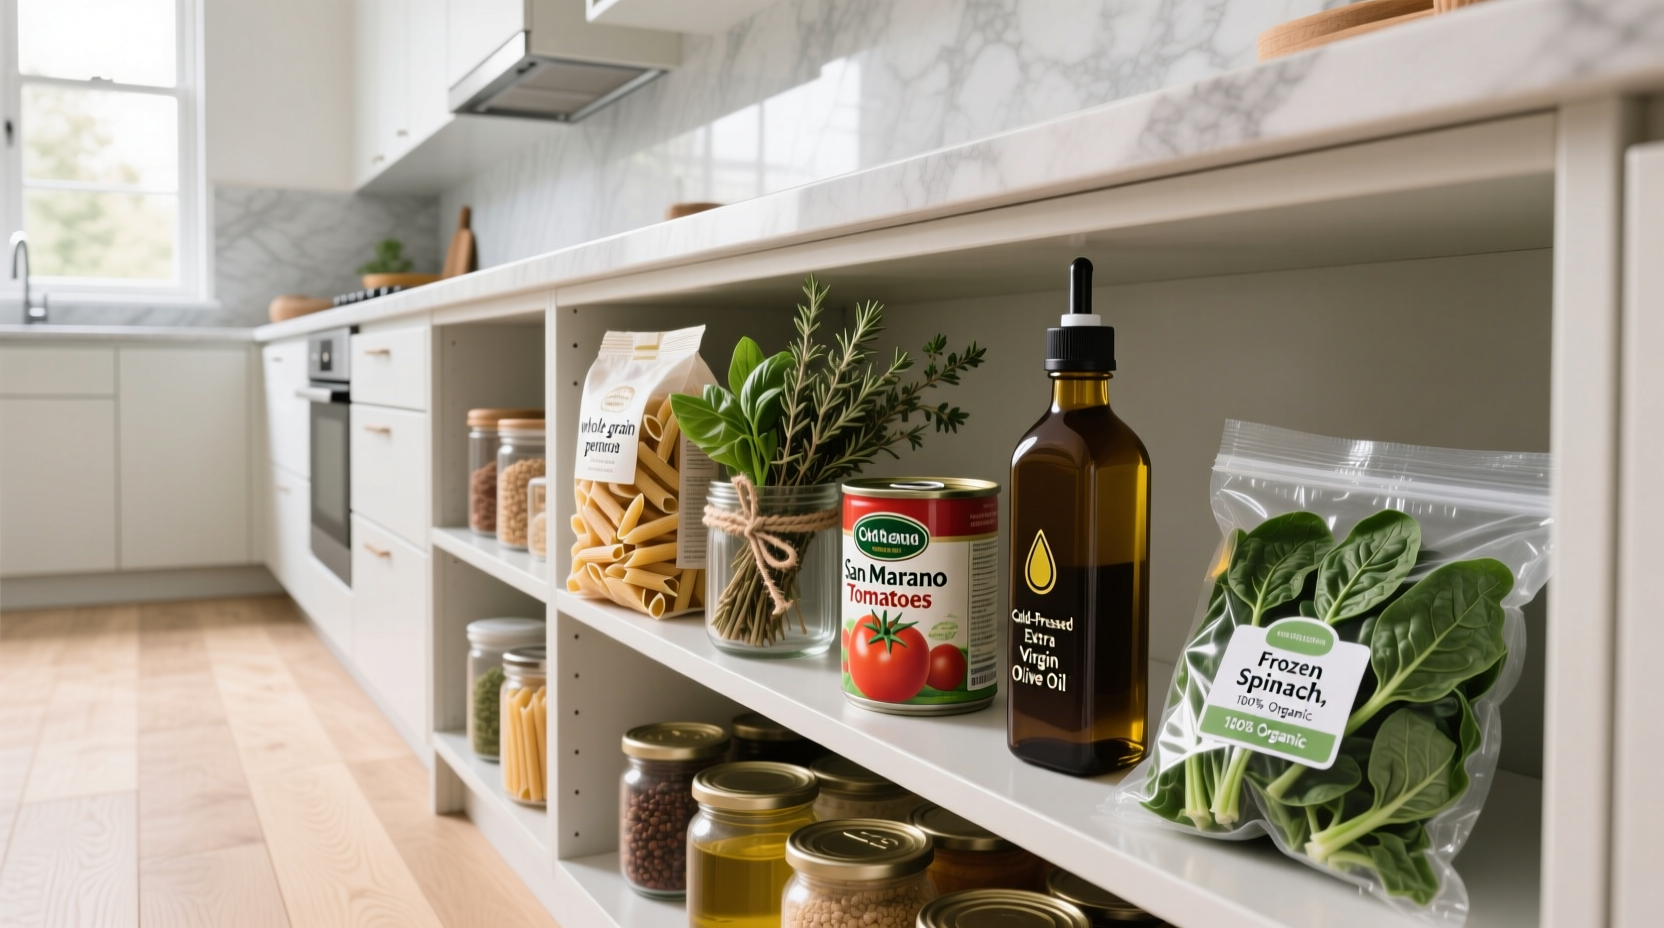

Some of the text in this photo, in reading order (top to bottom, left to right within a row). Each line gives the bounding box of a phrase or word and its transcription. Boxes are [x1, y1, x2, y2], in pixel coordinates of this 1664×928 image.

[606, 419, 635, 438] grain
[845, 558, 948, 588] San Marano
[846, 582, 932, 609] Tomatoes
[1019, 644, 1059, 671] Virgin
[1257, 651, 1323, 680] Frozen
[1011, 664, 1067, 692] Olive Oil
[1236, 667, 1327, 708] Spinach,
[1236, 694, 1313, 722] 100% Organic
[1257, 722, 1309, 749] Organic
